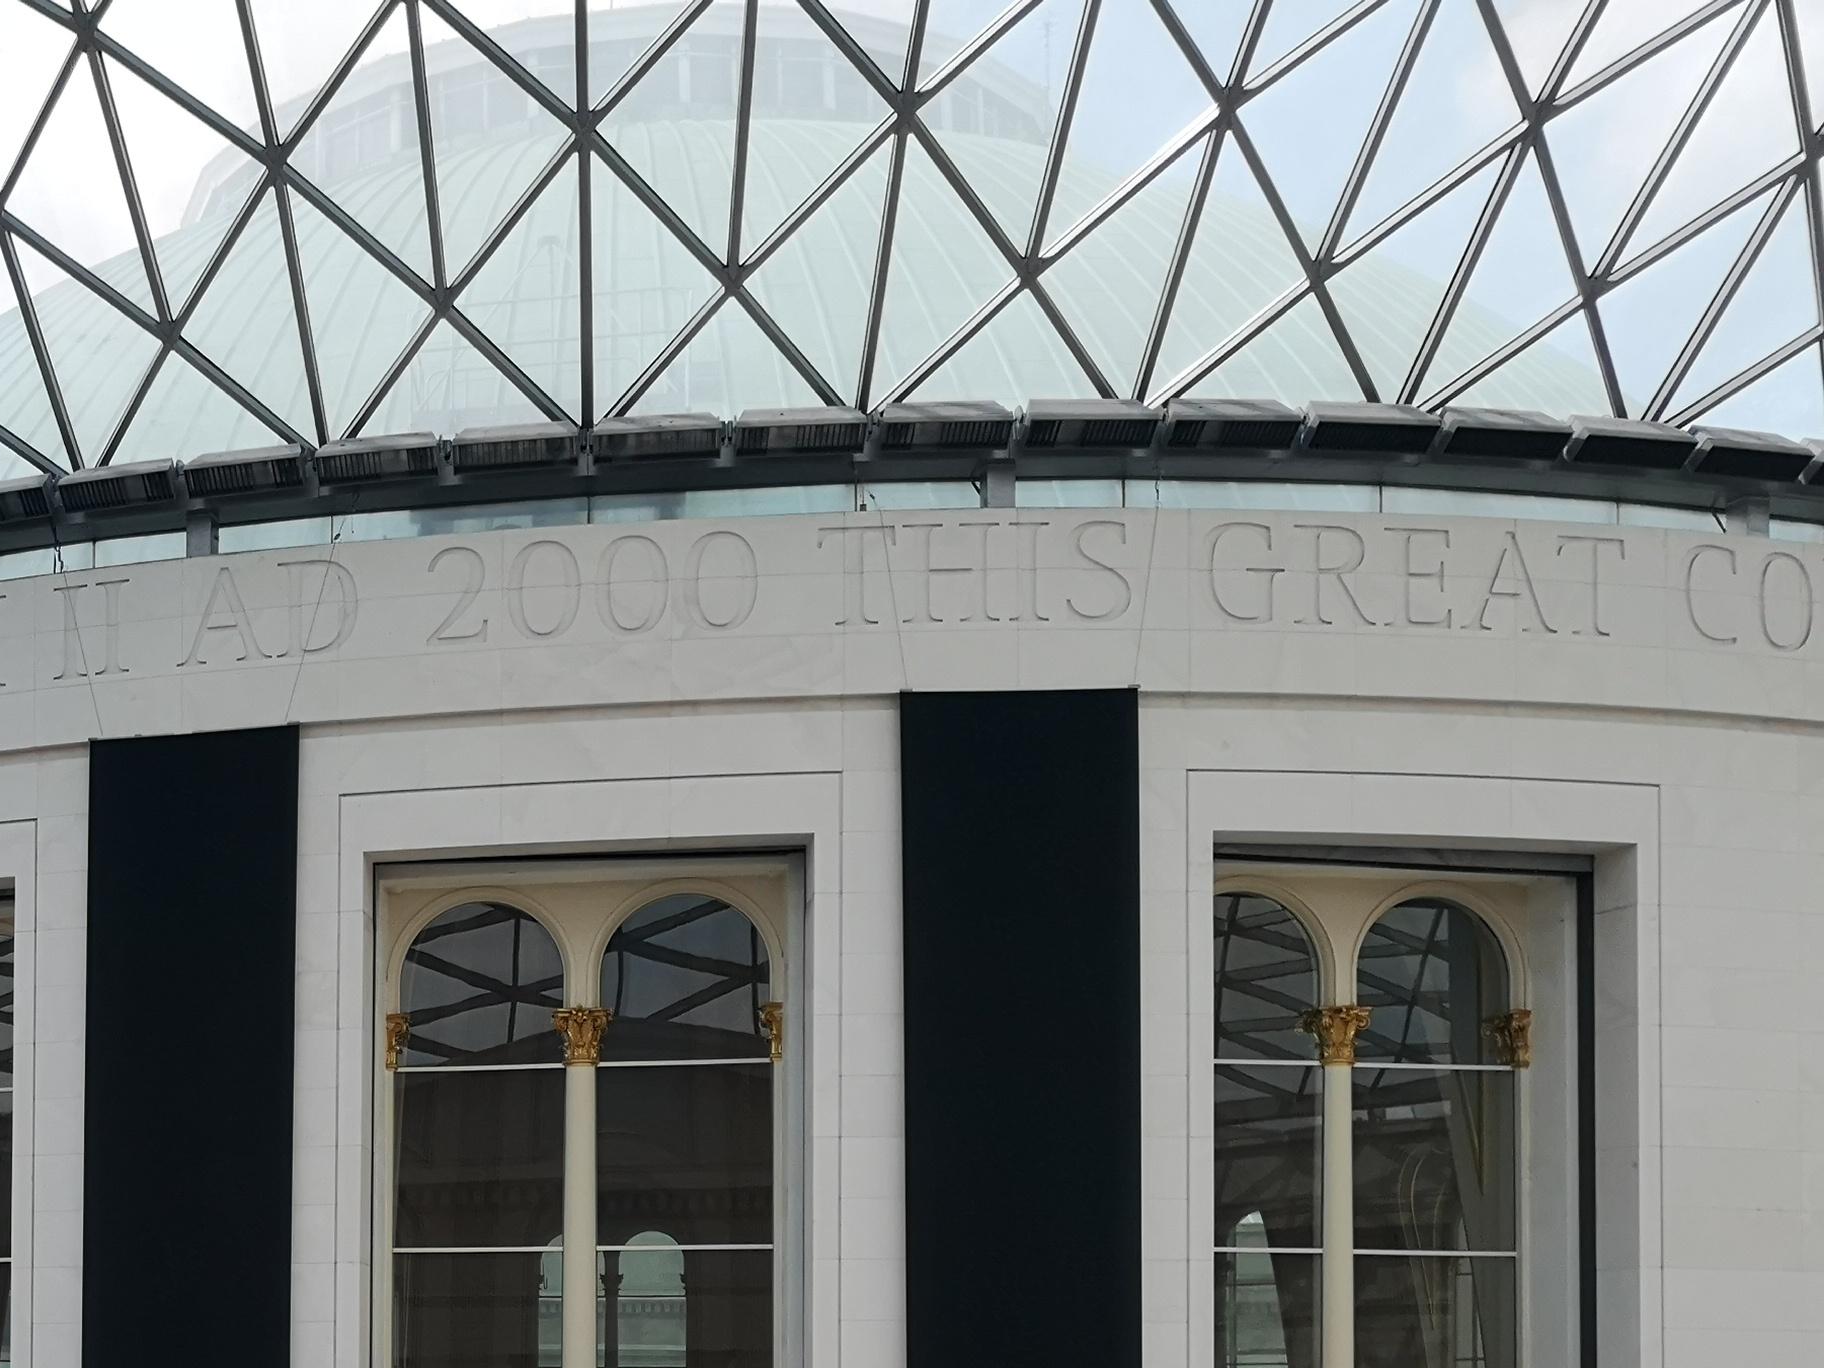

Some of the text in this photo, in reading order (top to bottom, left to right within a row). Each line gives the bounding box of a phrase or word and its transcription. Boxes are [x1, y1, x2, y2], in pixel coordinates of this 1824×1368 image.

[53, 578, 130, 681] II
[177, 559, 359, 669] AD
[426, 529, 760, 646] 2000
[815, 520, 1134, 628] THIS
[1208, 520, 1626, 637] GREAT
[1686, 543, 1824, 653] CO
